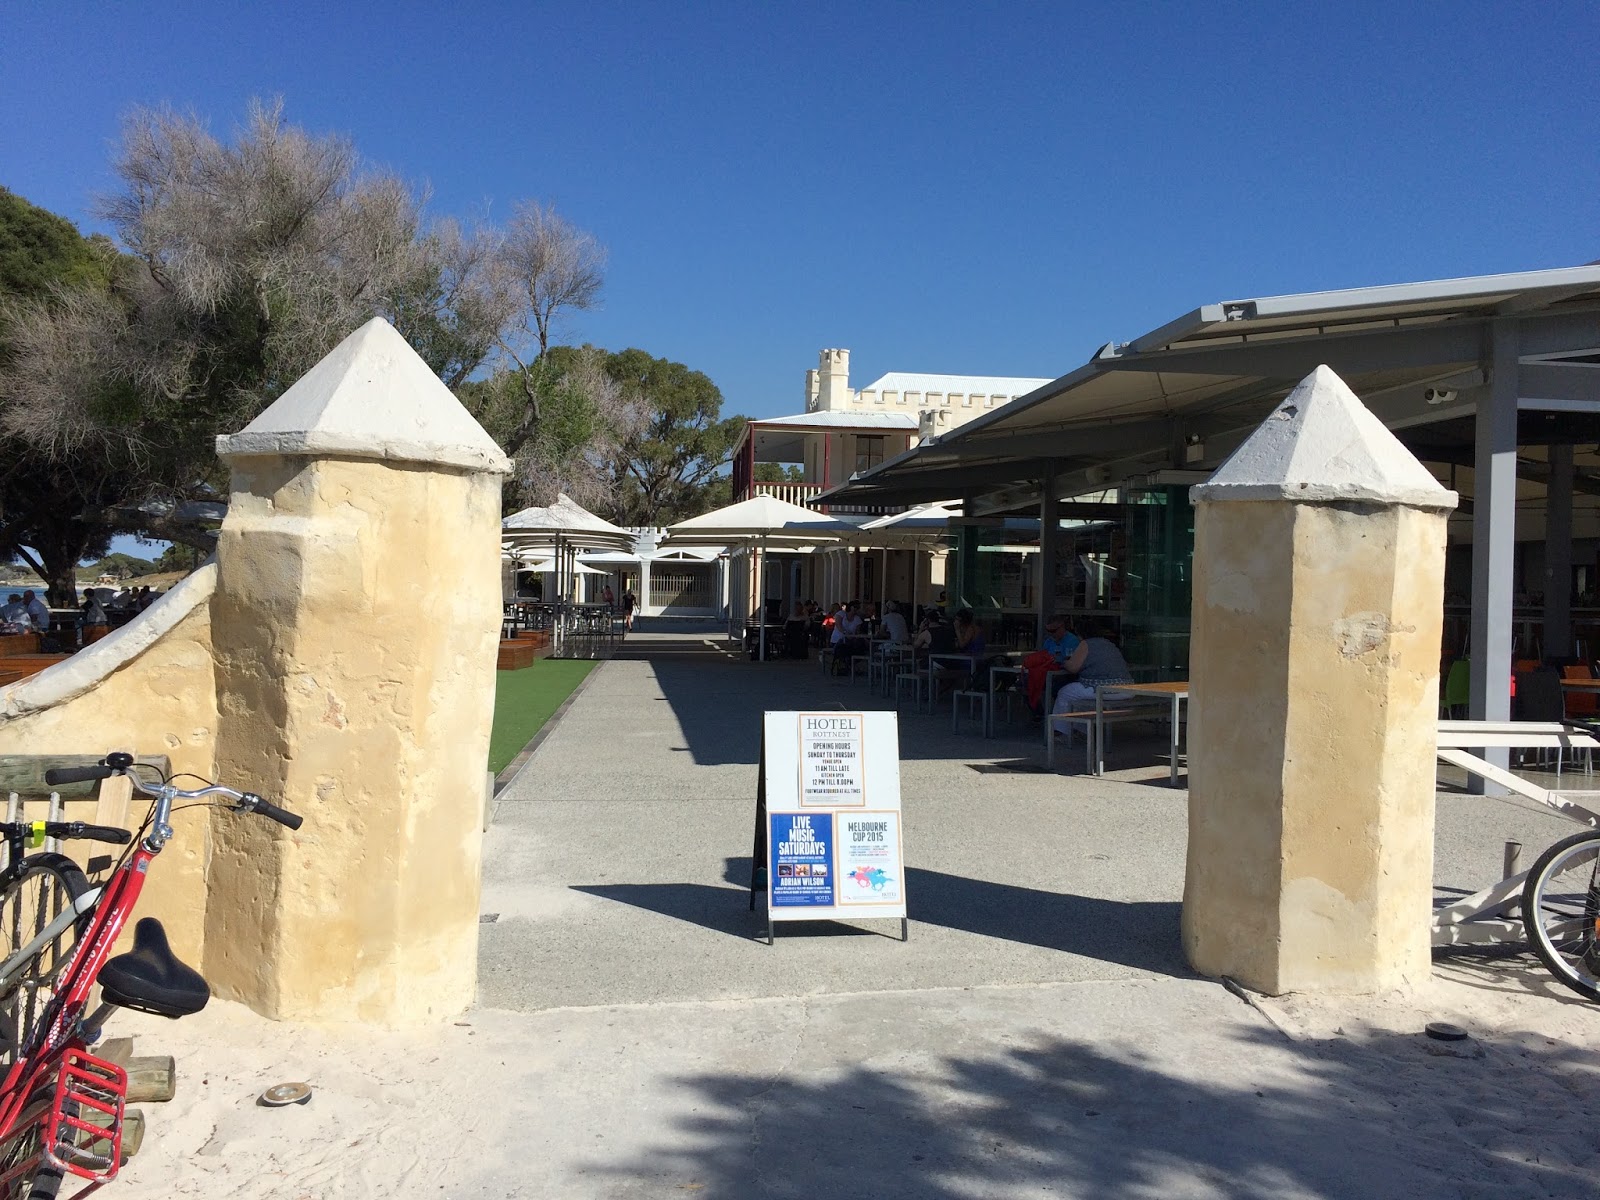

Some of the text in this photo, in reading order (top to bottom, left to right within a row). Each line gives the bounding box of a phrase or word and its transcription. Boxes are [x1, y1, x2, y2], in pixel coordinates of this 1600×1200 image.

[806, 718, 856, 730] HOTEL
[812, 742, 851, 750] OPENING HOURS
[792, 816, 811, 829] LIVE
[848, 821, 888, 832] MELBOURNE
[788, 828, 815, 842] MUSIC
[852, 832, 884, 842] CUP 2015
[778, 842, 826, 855] SATURDAYS
[780, 877, 825, 886] ADRIAN WILSON
